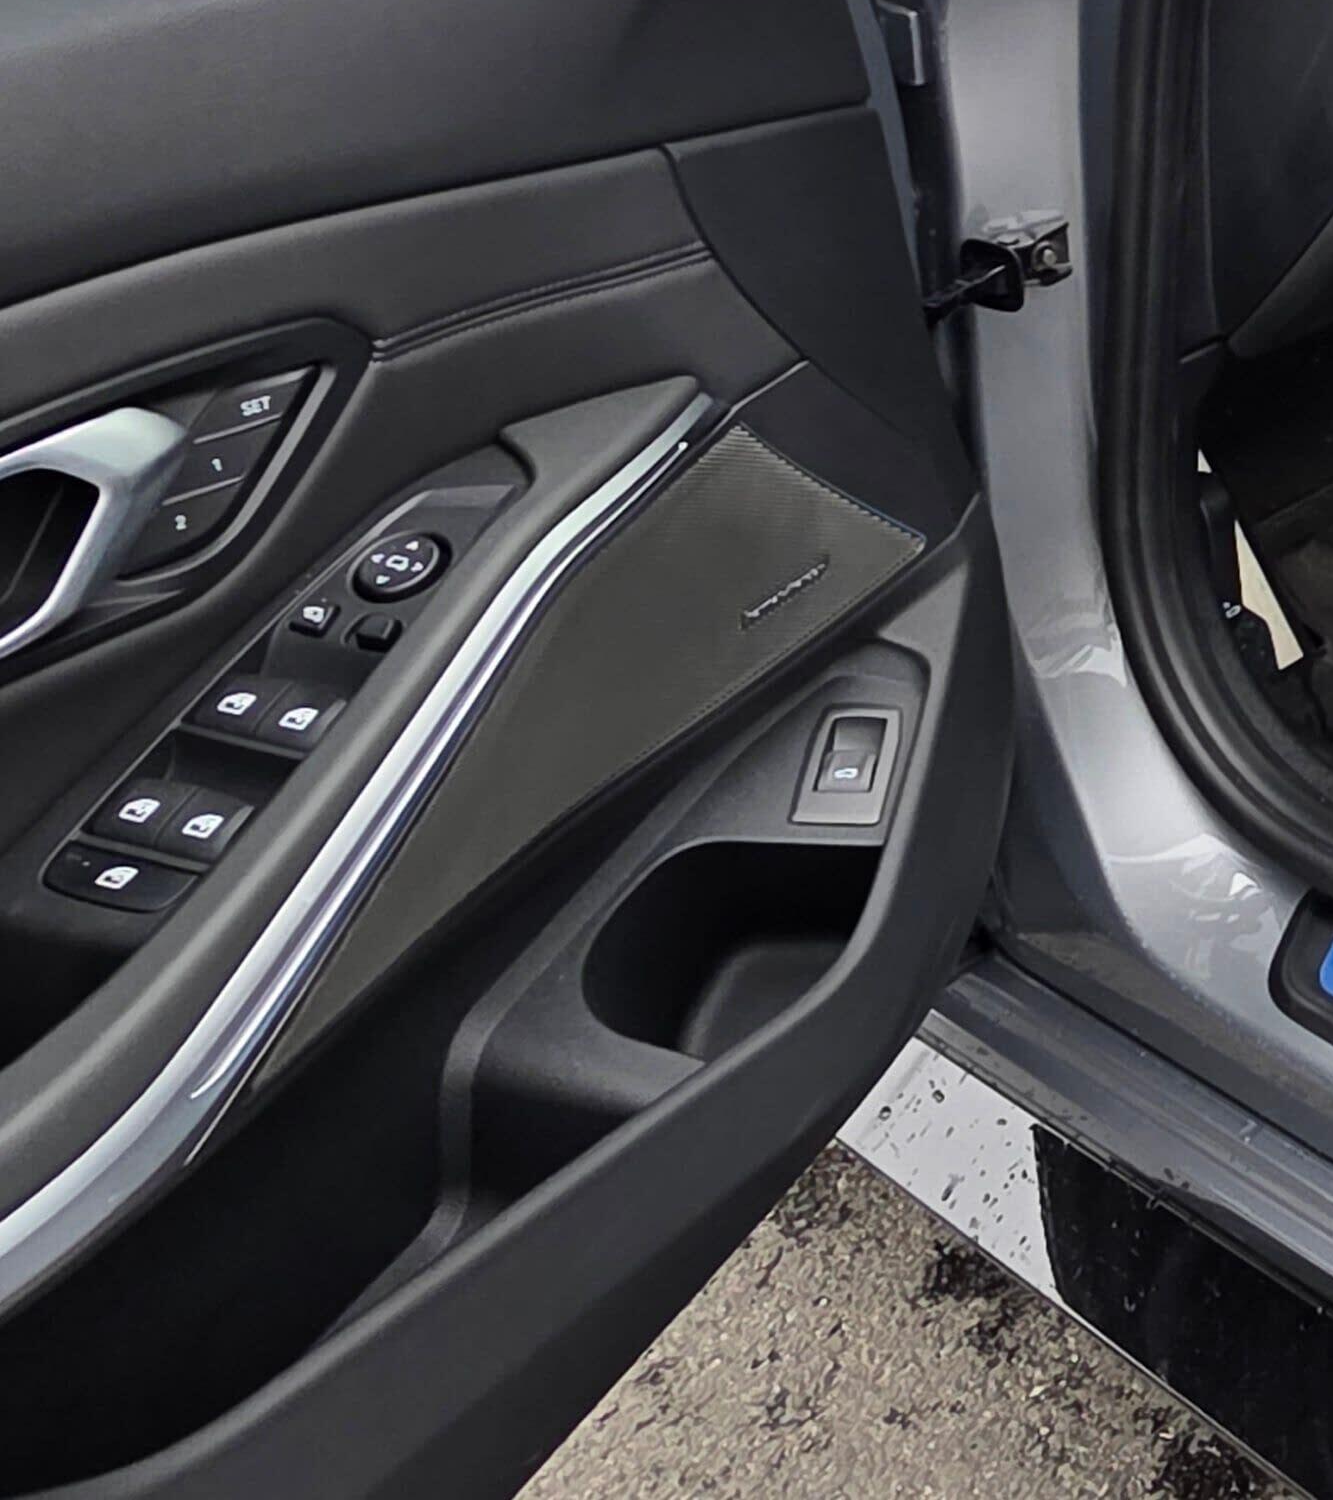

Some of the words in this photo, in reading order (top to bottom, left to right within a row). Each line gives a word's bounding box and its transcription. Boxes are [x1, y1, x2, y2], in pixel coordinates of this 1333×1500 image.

[240, 395, 272, 417] SET
[211, 457, 223, 473] 1
[174, 514, 187, 531] 2
